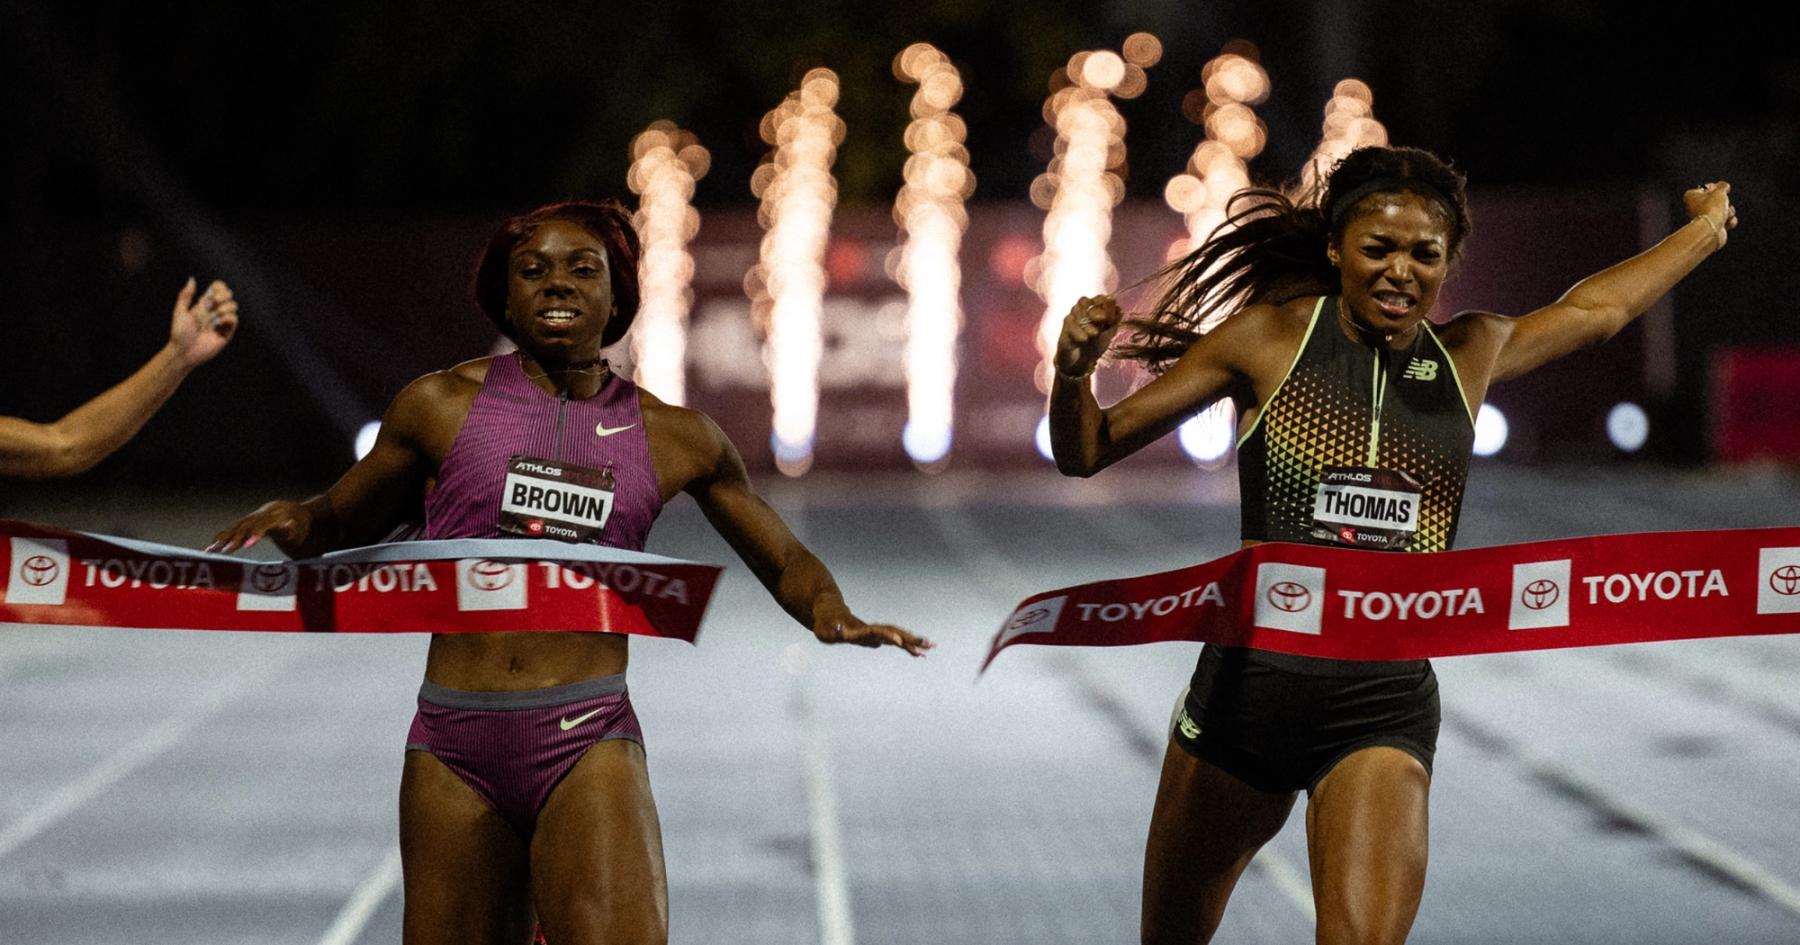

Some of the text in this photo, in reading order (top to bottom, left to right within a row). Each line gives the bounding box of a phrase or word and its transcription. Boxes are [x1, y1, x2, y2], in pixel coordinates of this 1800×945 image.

[515, 462, 562, 476] ATHLOS
[1327, 473, 1372, 482] ATHLOS
[511, 483, 605, 522] BROWN
[1324, 490, 1411, 523] THOMAS
[545, 525, 578, 538] TOYOTA
[1357, 532, 1388, 543] TOYOTA
[81, 559, 690, 605] TOYOTA TOYOTA TOYOTA
[1077, 569, 1730, 622] TOYOTA TOYOTA TOYOTA
